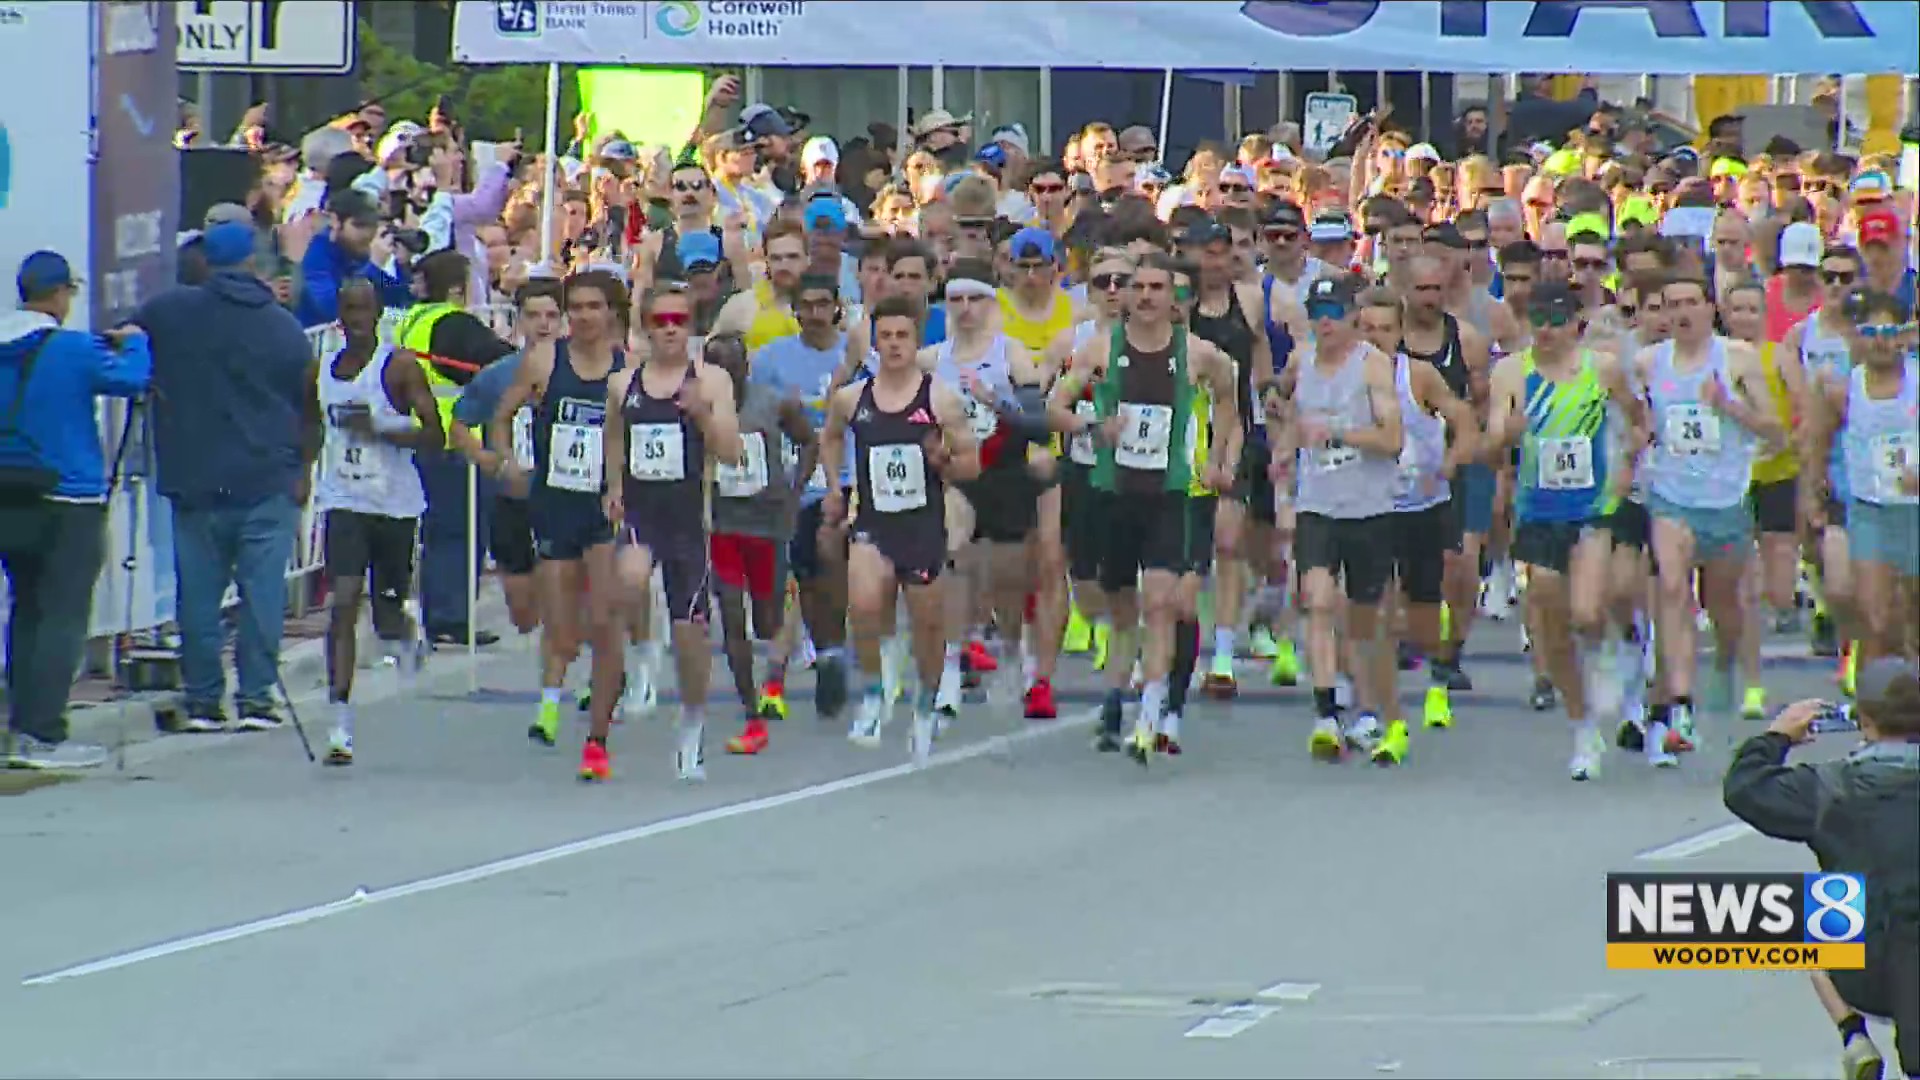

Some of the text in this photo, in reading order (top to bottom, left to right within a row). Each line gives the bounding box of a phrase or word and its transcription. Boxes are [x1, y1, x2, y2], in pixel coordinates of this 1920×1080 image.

[708, 1, 803, 15] Corewell
[545, 17, 586, 29] BANK
[708, 19, 779, 36] Health
